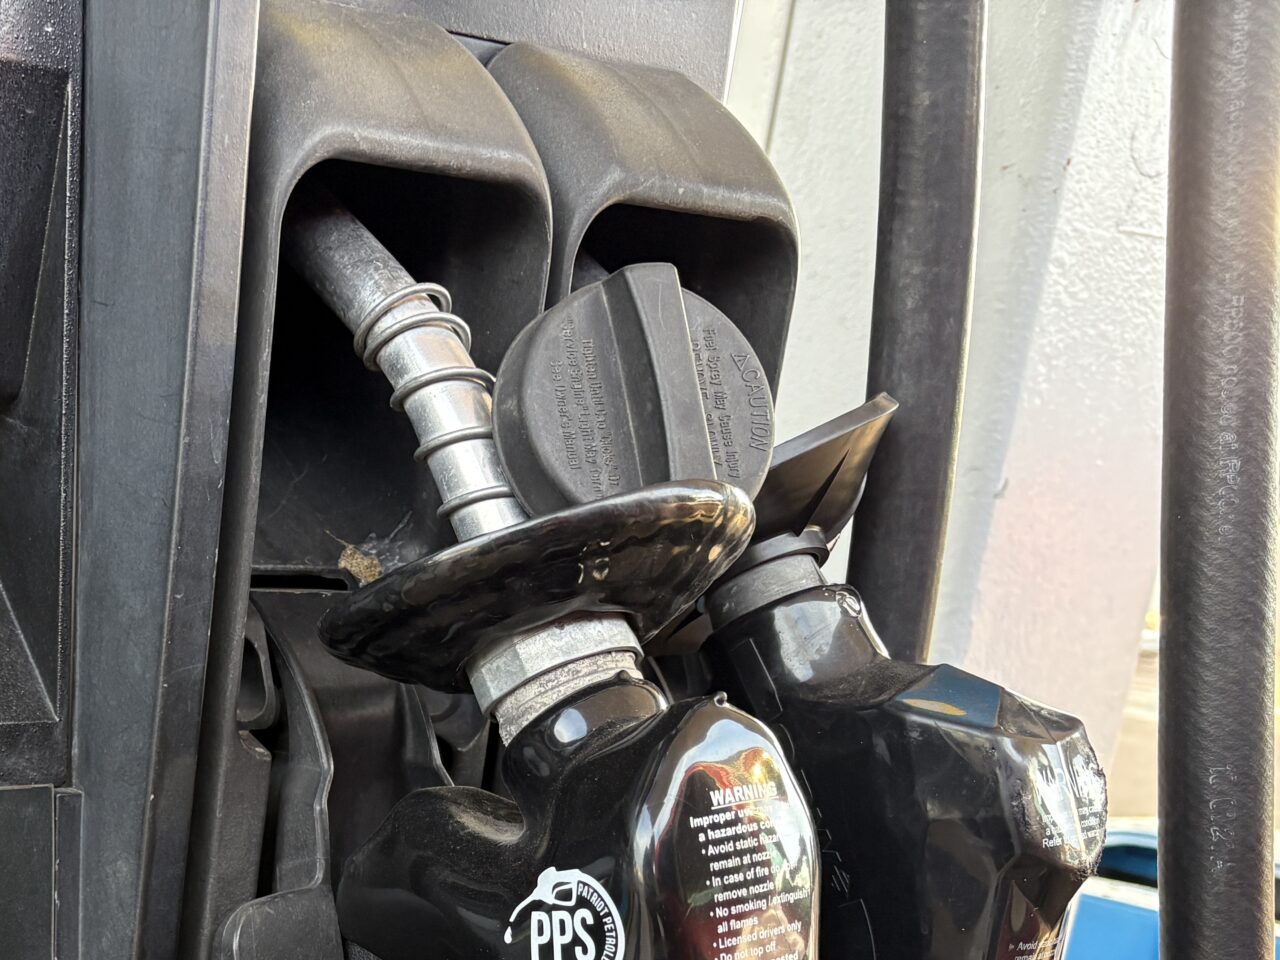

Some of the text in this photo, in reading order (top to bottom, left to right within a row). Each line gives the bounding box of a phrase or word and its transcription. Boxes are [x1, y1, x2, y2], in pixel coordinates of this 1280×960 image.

[702, 328, 719, 351] Fuel
[714, 390, 729, 411] May
[742, 368, 770, 451] CAUTION
[718, 415, 735, 447] Cause
[710, 781, 777, 806] WARNING
[690, 810, 735, 828] Improper
[699, 833, 705, 841] a
[708, 822, 758, 840] hazardous
[708, 841, 734, 856] Avoid
[736, 836, 758, 850] static
[710, 856, 741, 871] remain
[743, 853, 751, 863] at
[712, 876, 721, 887] In
[724, 872, 744, 885] case
[746, 868, 755, 879] of
[756, 866, 769, 878] fire
[577, 883, 607, 916] PATRIOT
[714, 880, 774, 902] remove nozzle
[716, 906, 728, 918] No
[731, 898, 767, 914] smoking
[718, 916, 758, 934] all flames
[719, 920, 801, 949] Licensed drivers only
[766, 941, 776, 952] off
